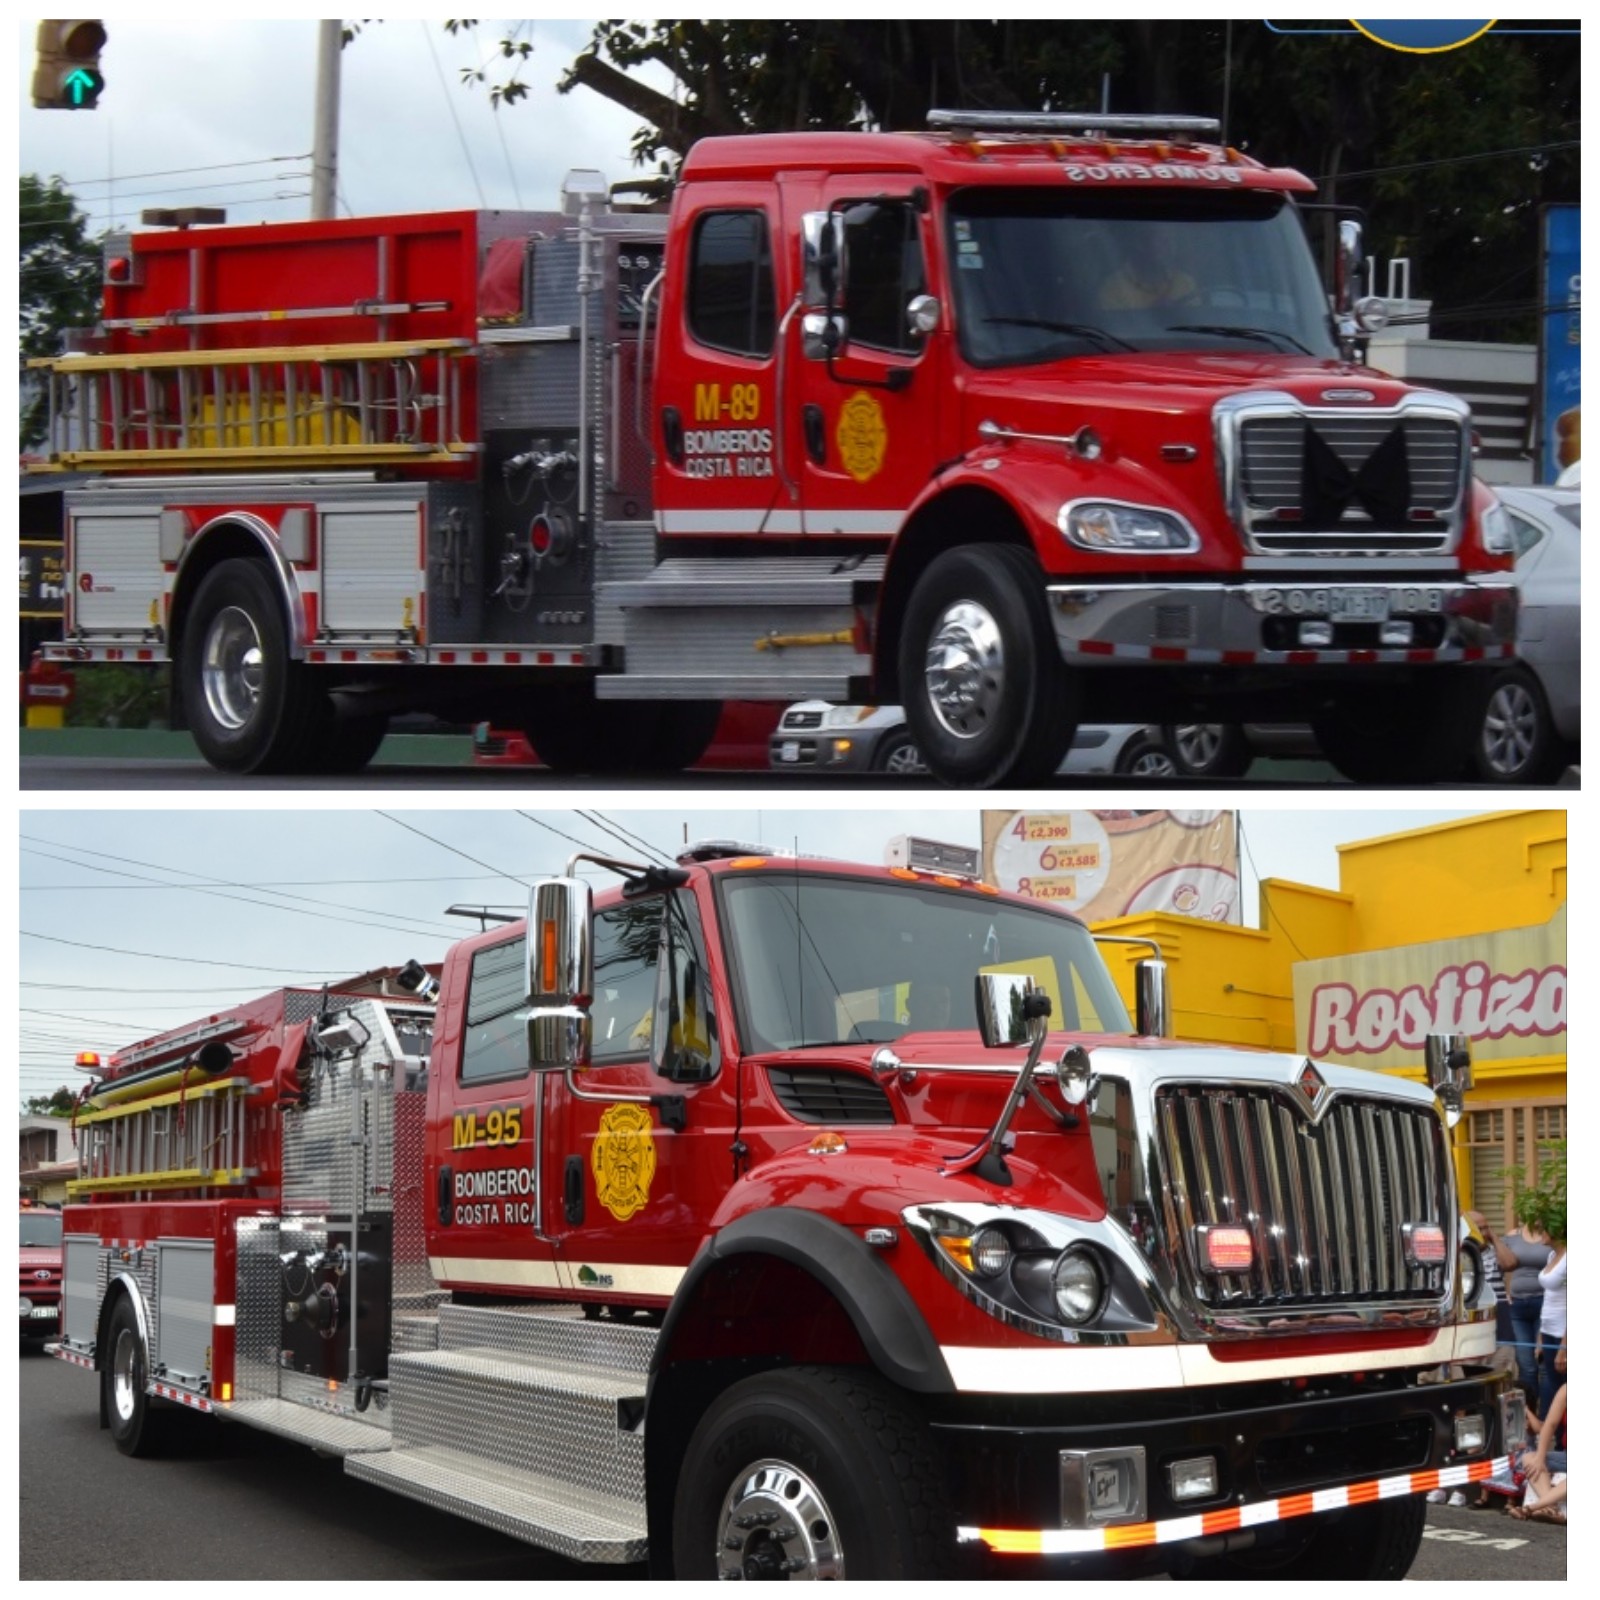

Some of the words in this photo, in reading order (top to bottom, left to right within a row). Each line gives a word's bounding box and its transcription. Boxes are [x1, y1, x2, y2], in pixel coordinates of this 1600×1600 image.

[695, 383, 760, 420] M-89
[684, 429, 773, 454] BOMBEROS
[686, 457, 732, 478] COSTA
[737, 456, 774, 477] RICA
[1012, 816, 1027, 842] 4
[1040, 845, 1057, 871] 6
[453, 1107, 521, 1150] M-95
[455, 1205, 499, 1225] COSTA
